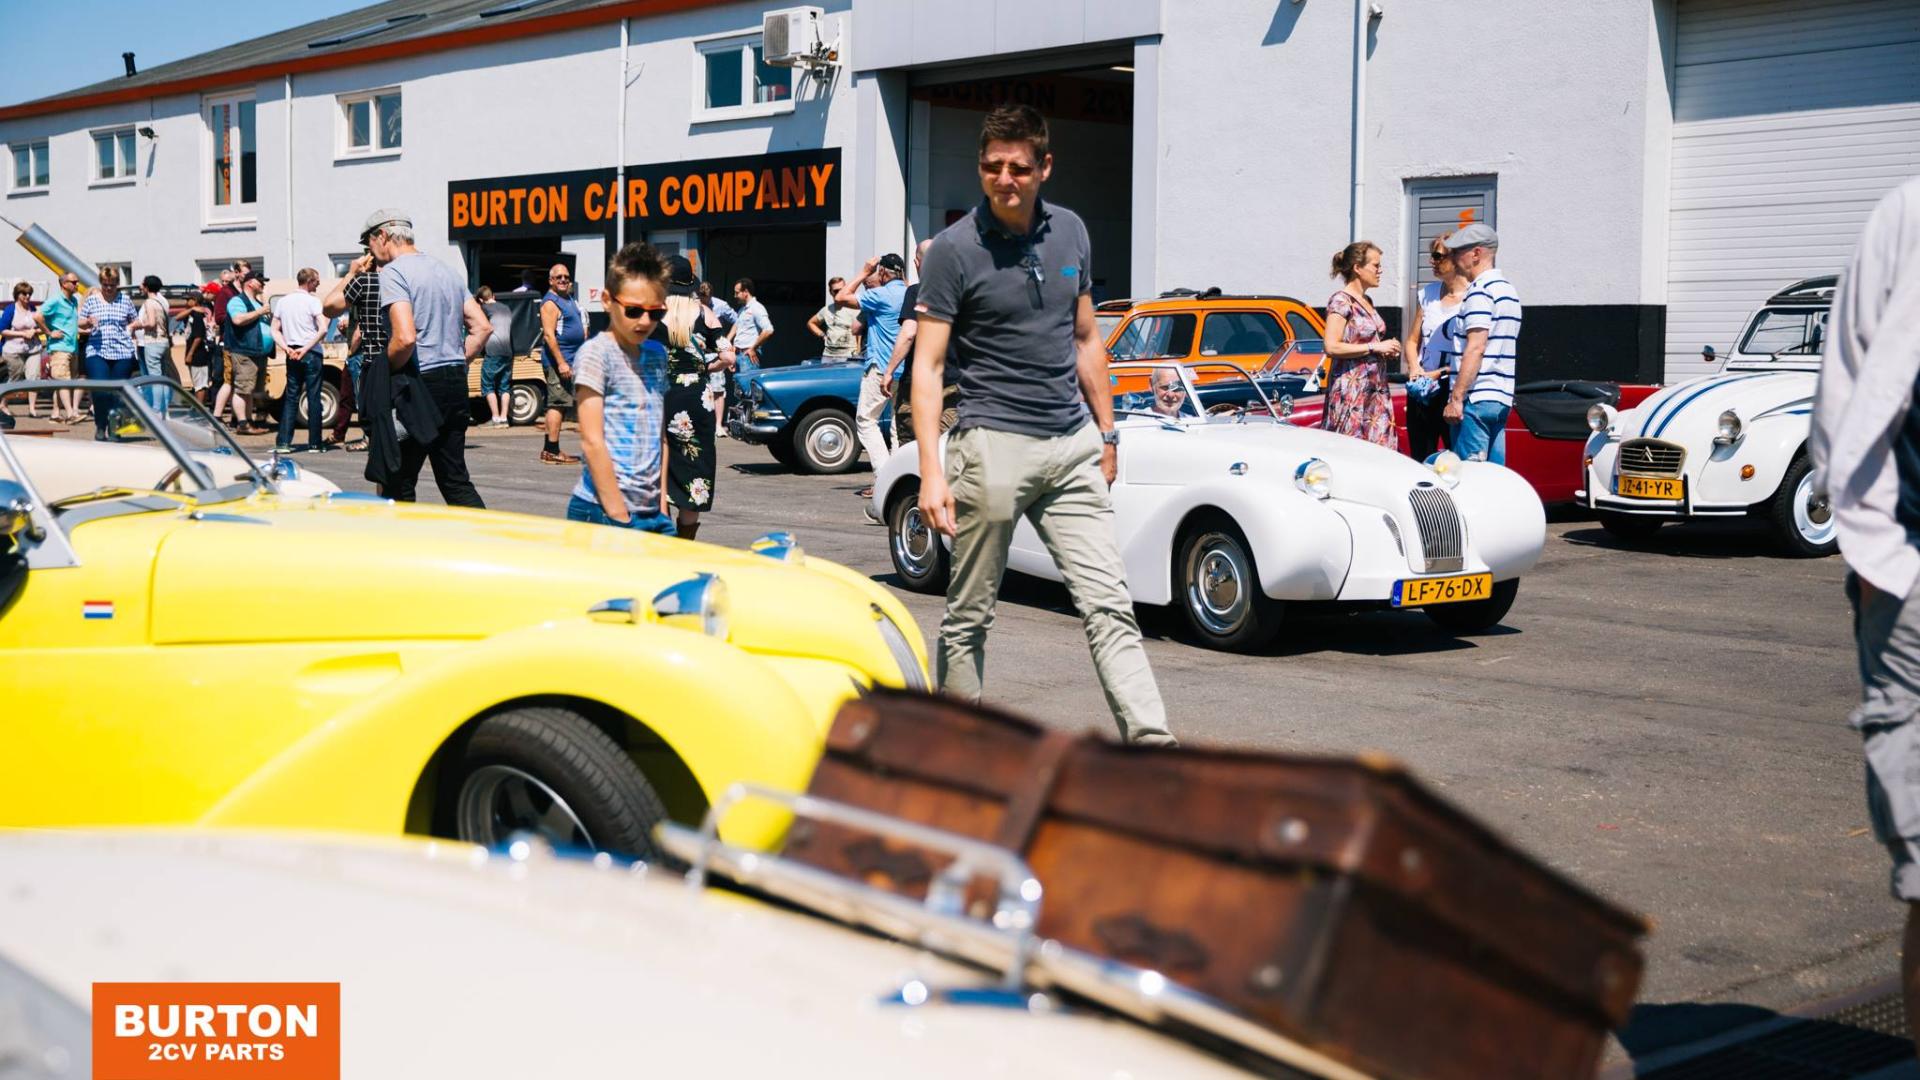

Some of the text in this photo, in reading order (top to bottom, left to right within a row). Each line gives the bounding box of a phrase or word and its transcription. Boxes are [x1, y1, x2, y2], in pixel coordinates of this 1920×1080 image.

[452, 163, 834, 229] BURTON CAR COMPANY
[1622, 479, 1673, 497] JZ-41-YR
[1408, 578, 1483, 601] LF-76-DX
